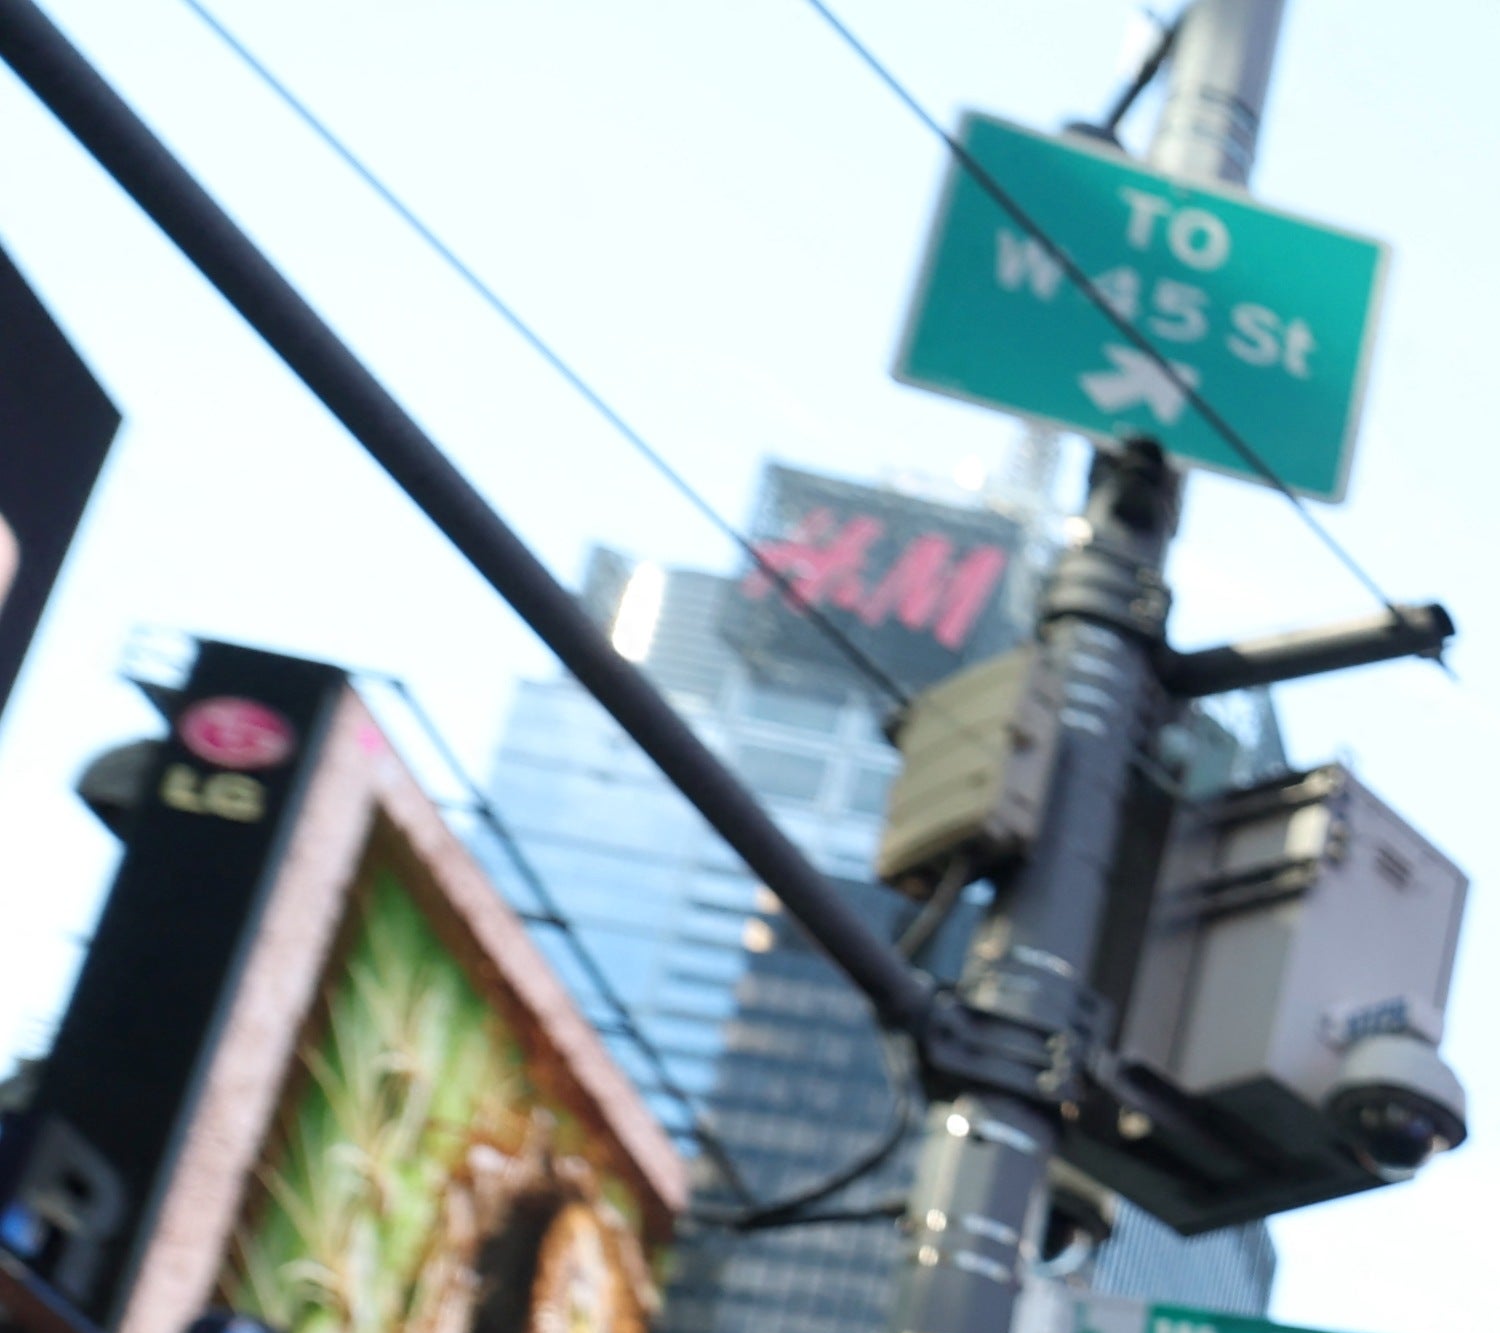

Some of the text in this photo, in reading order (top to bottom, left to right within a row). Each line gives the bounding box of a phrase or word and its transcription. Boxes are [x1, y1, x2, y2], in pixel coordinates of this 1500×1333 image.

[1114, 183, 1232, 271] TO
[995, 224, 1316, 379] W 45 St
[160, 762, 266, 823] LG
